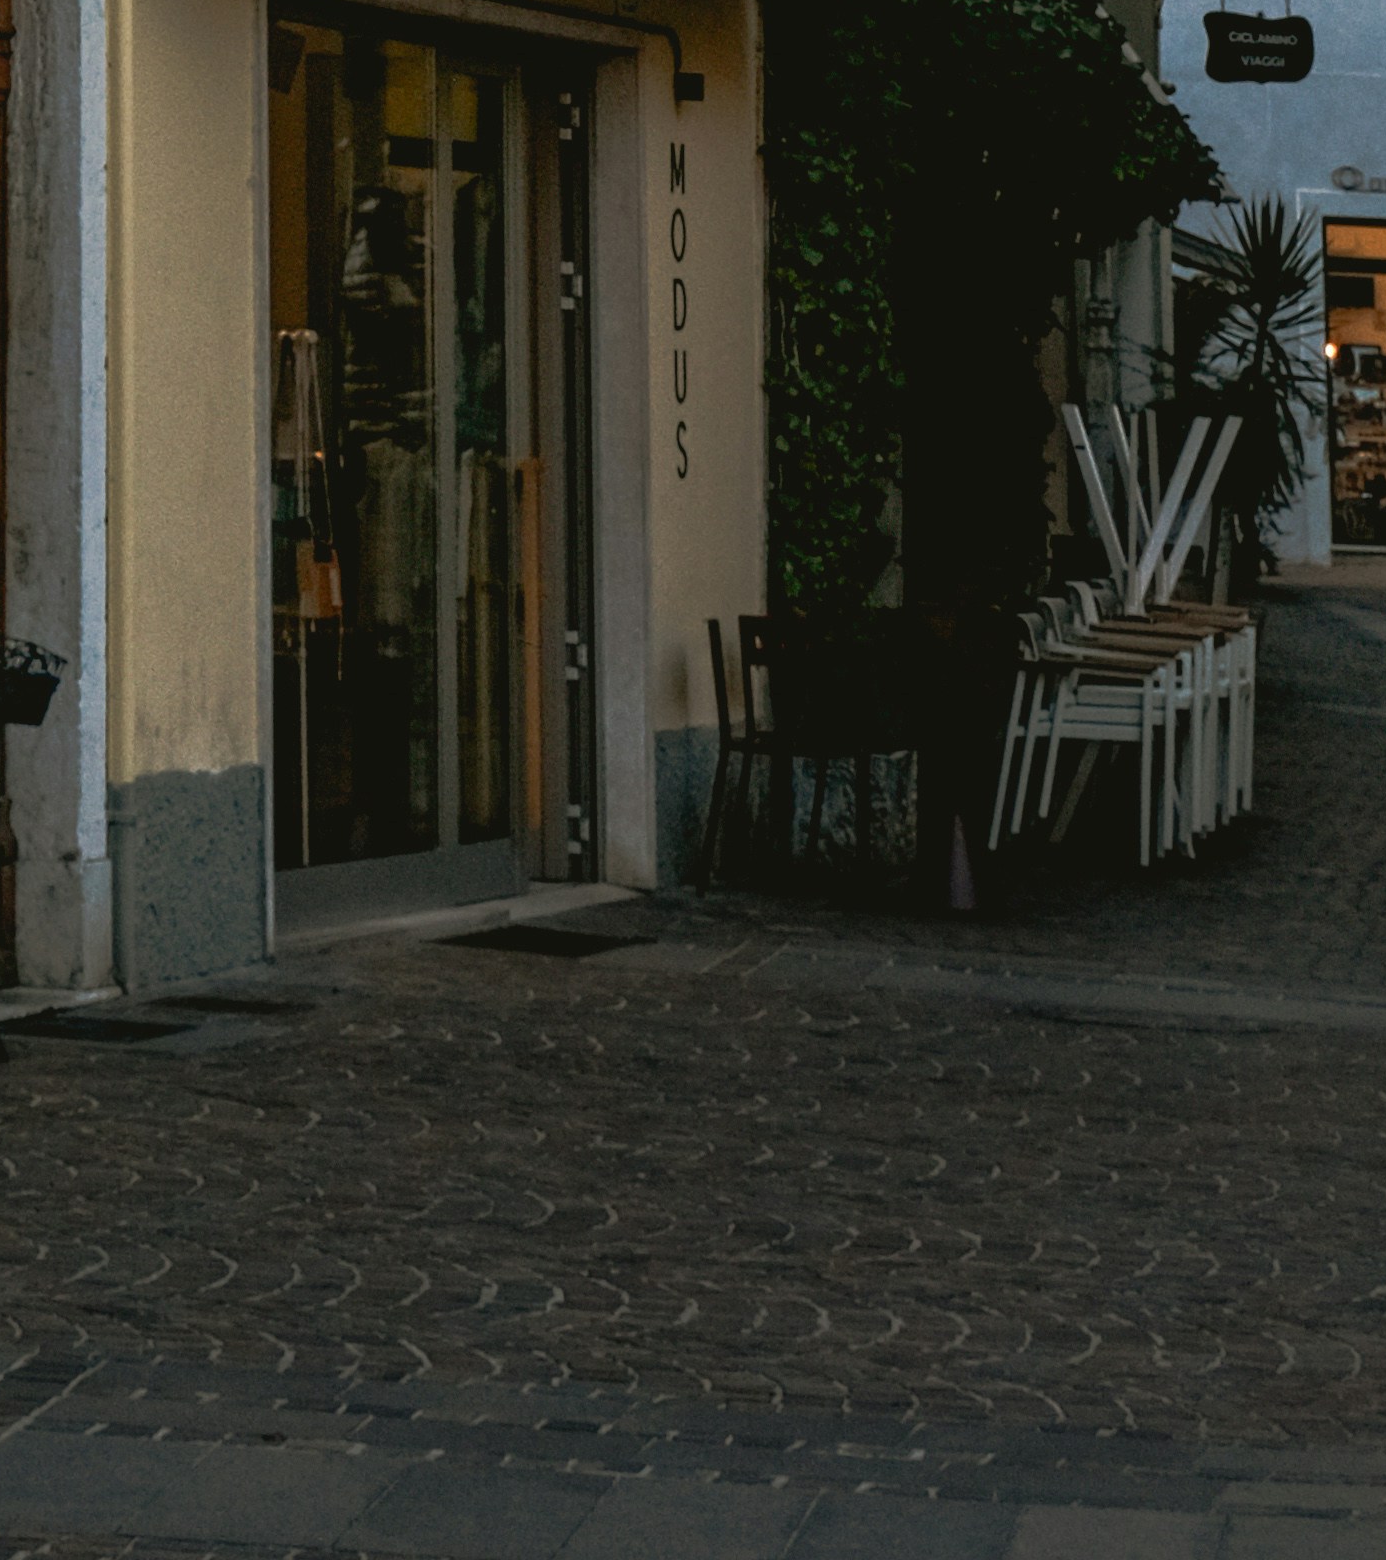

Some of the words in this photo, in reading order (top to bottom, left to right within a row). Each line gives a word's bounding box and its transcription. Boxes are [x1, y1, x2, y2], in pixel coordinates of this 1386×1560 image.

[1228, 30, 1299, 47] CICLAMINO
[1240, 55, 1286, 68] VIAGGI
[669, 141, 688, 480] MODUS
